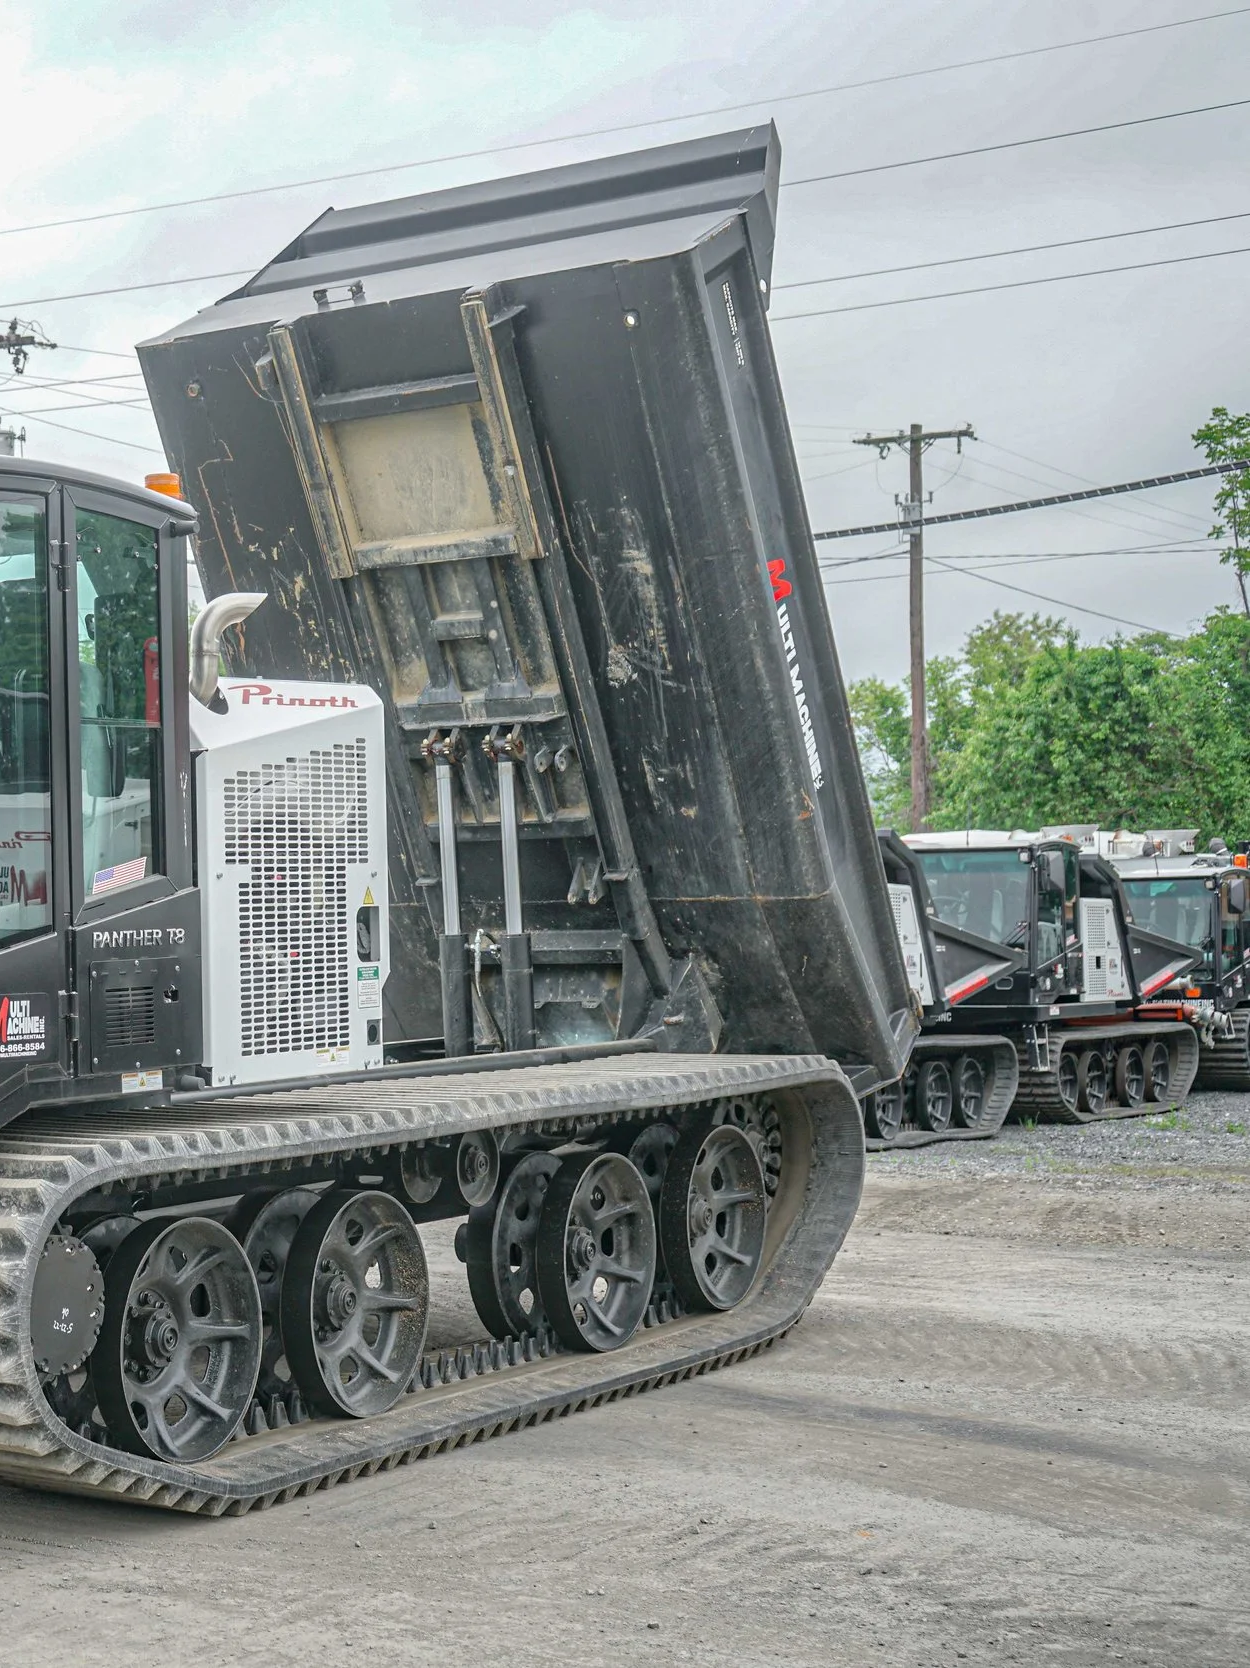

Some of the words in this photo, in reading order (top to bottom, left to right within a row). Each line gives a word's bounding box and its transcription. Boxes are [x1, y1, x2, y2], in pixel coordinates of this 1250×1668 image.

[228, 684, 358, 708] Prinoth
[790, 663, 822, 781] MACHINE
[93, 929, 162, 948] PANTHER
[166, 928, 185, 945] T8
